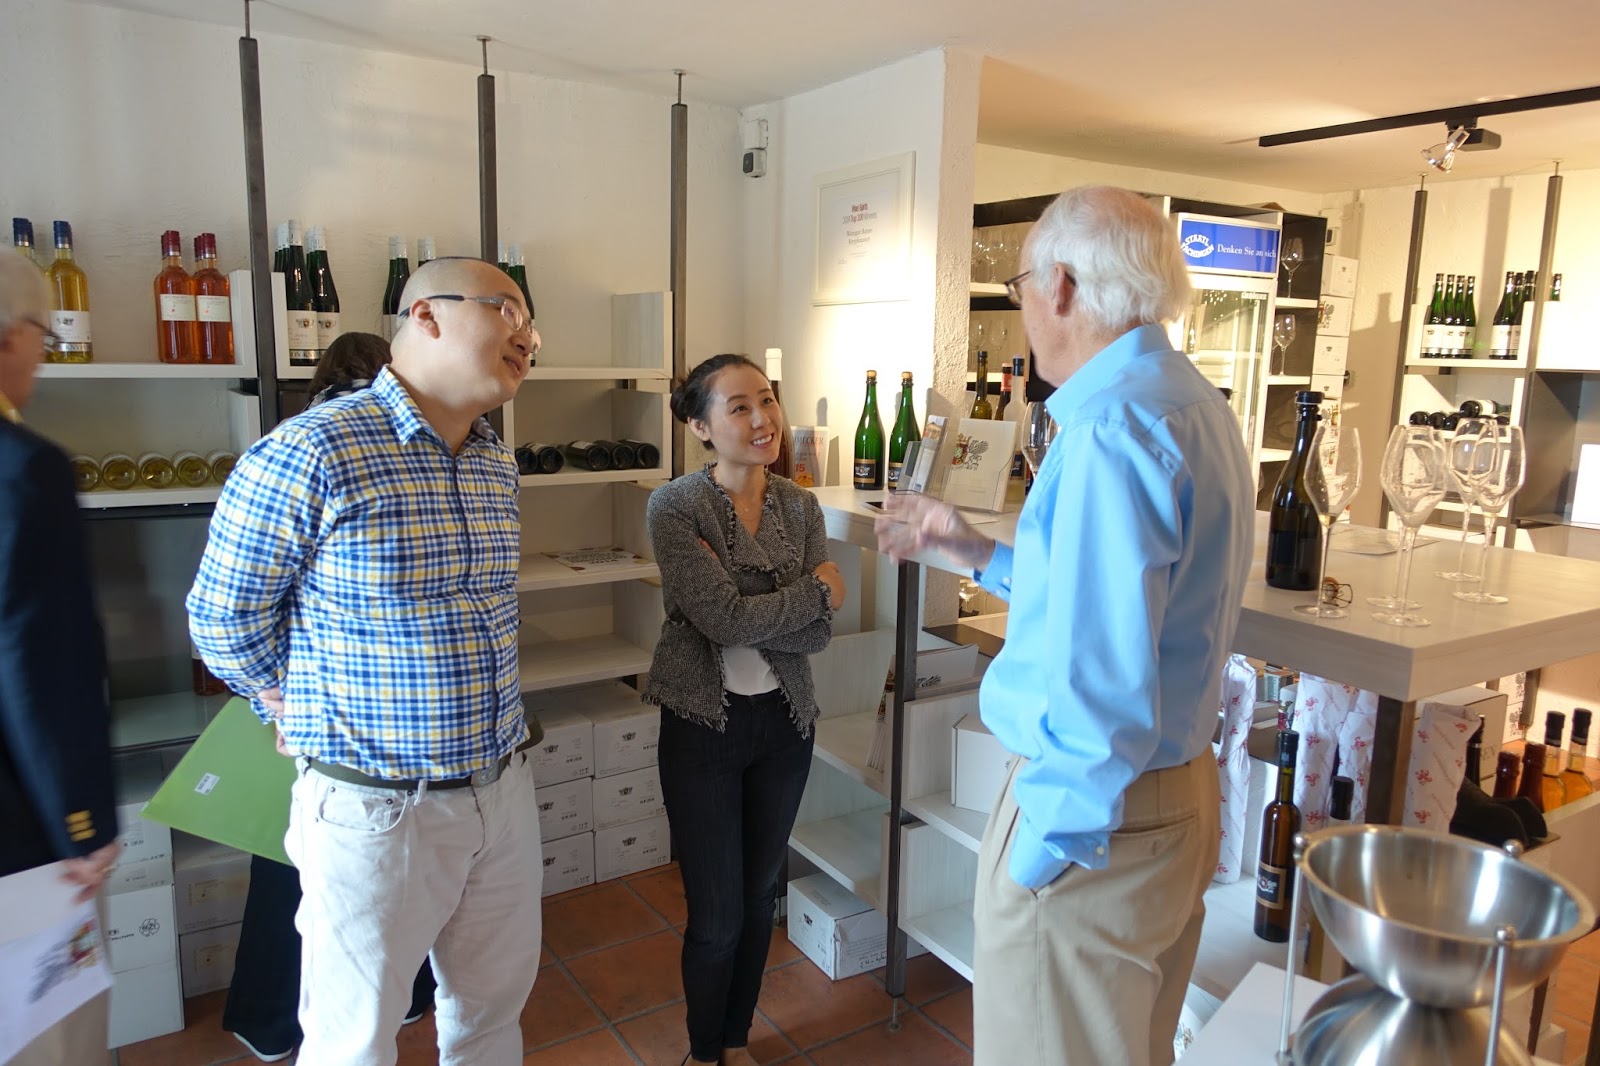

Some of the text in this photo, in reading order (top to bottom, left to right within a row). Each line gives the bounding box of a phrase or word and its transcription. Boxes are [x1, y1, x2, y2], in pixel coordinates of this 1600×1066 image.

[1217, 243, 1276, 258] Denken Sie an sich
